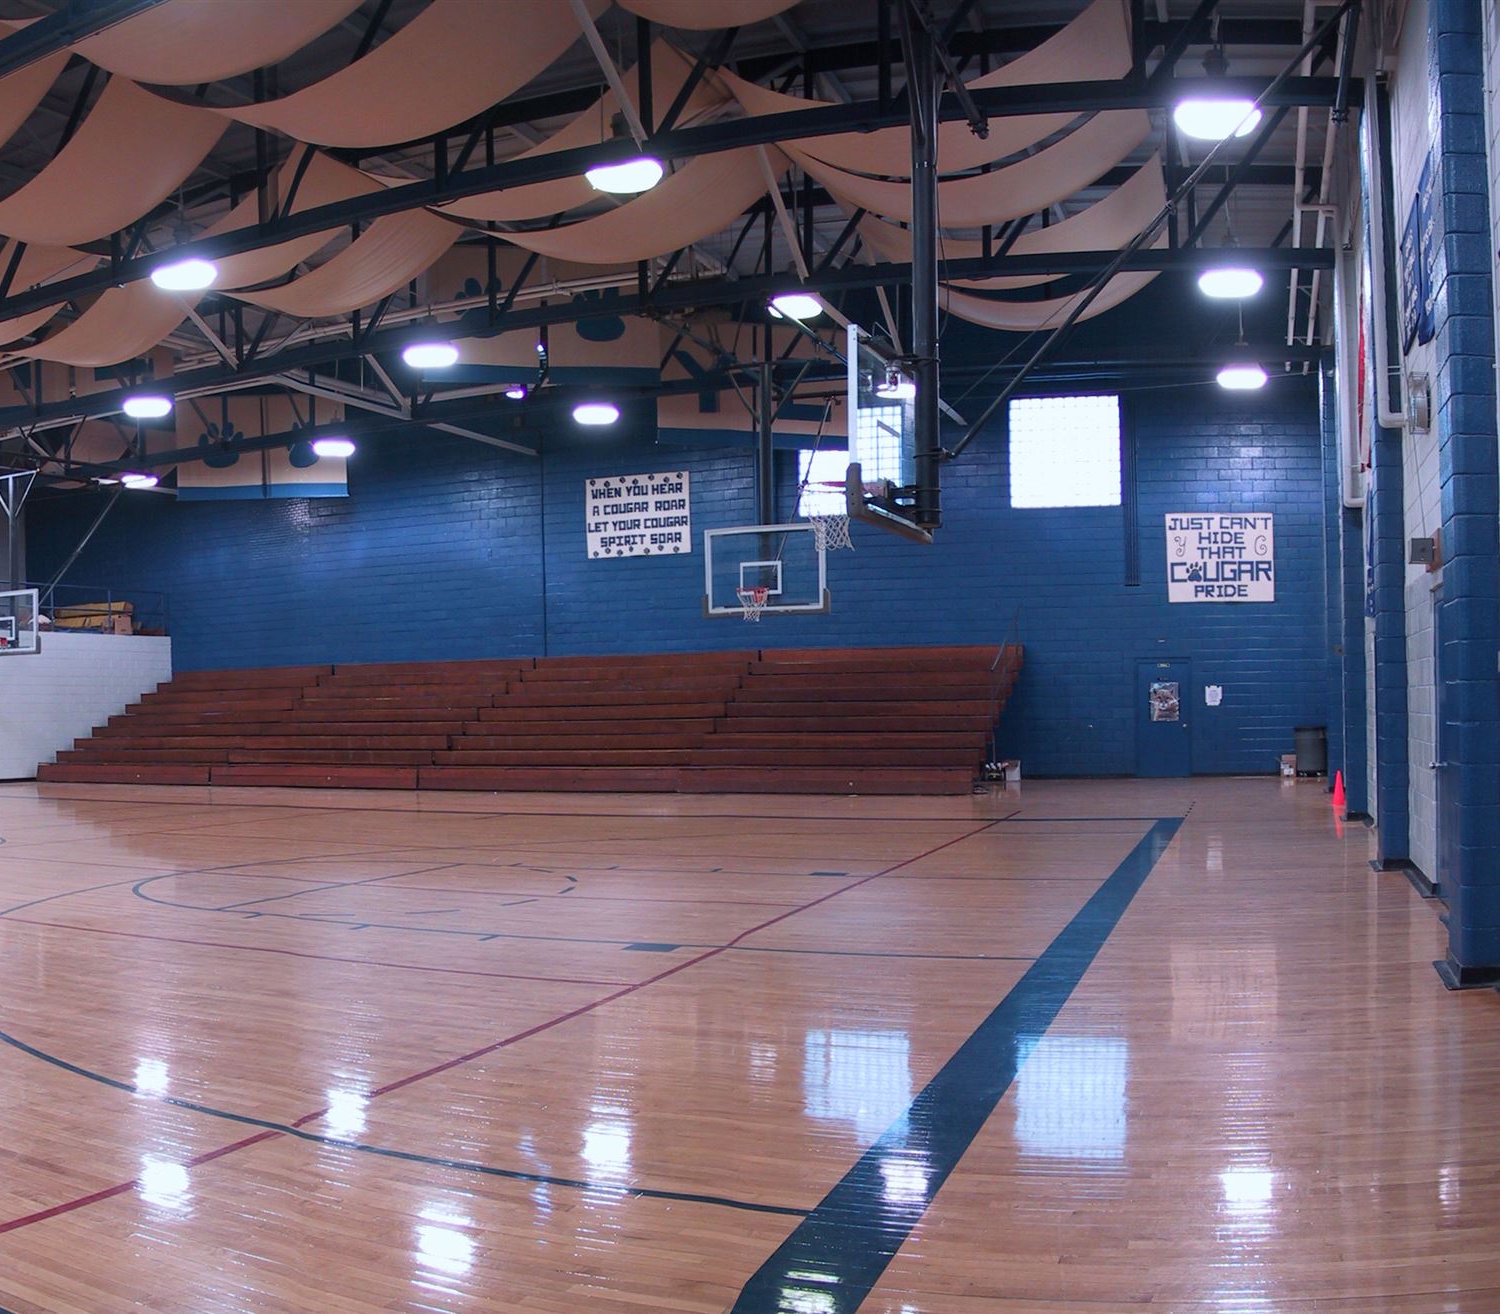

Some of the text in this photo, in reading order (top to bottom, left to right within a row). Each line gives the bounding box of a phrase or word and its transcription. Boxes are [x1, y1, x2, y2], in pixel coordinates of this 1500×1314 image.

[591, 482, 683, 499] WHEN YOU HEAR
[592, 499, 686, 516] A COUGAR ROAR
[588, 515, 688, 533] LET YOUR COUGAR
[1168, 517, 1271, 531] JUST CAN'T
[600, 532, 682, 548] SPIRIT SOAR
[1198, 532, 1245, 545] HIDE
[1197, 546, 1246, 559] THAT
[1194, 585, 1248, 598] PRIDE
